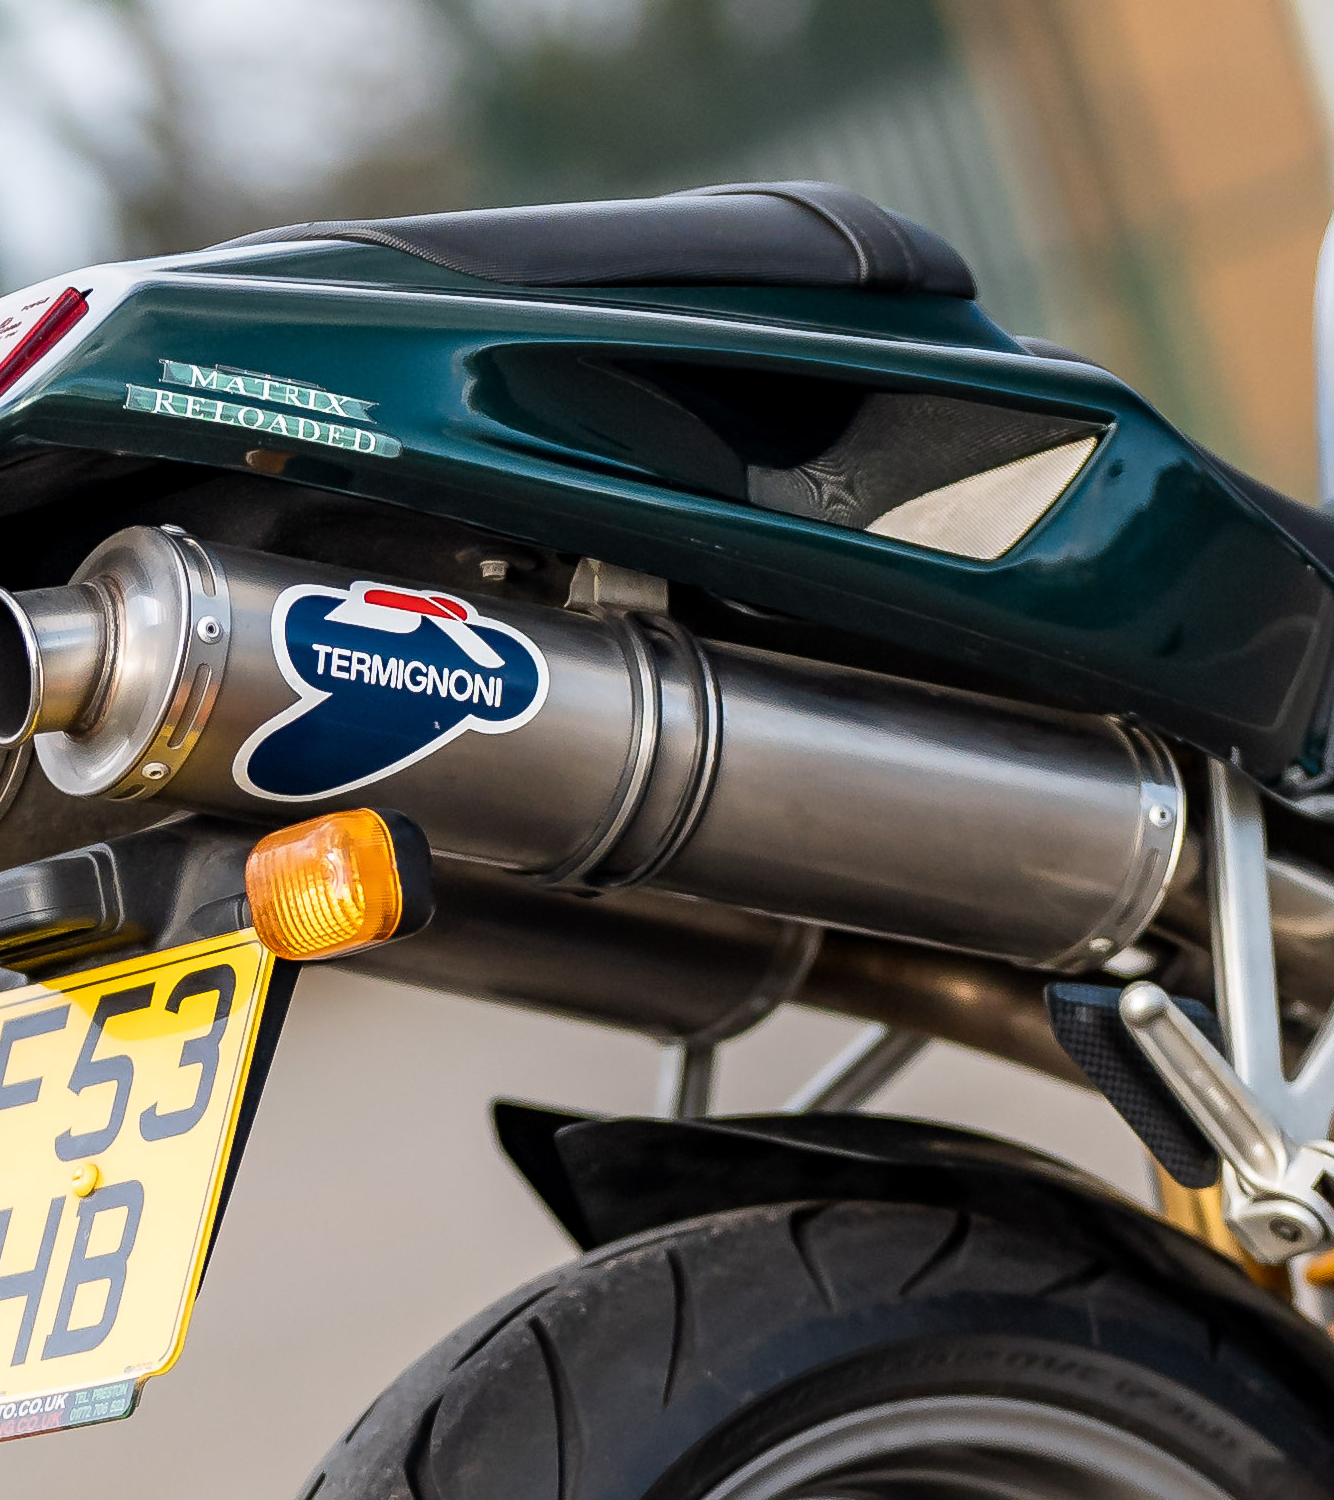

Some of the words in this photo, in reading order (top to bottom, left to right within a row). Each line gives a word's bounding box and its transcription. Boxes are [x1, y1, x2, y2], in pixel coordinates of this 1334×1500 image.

[150, 389, 376, 454] RELOADED
[189, 364, 352, 417] MATRIX
[312, 643, 503, 708] TERMIGNONI
